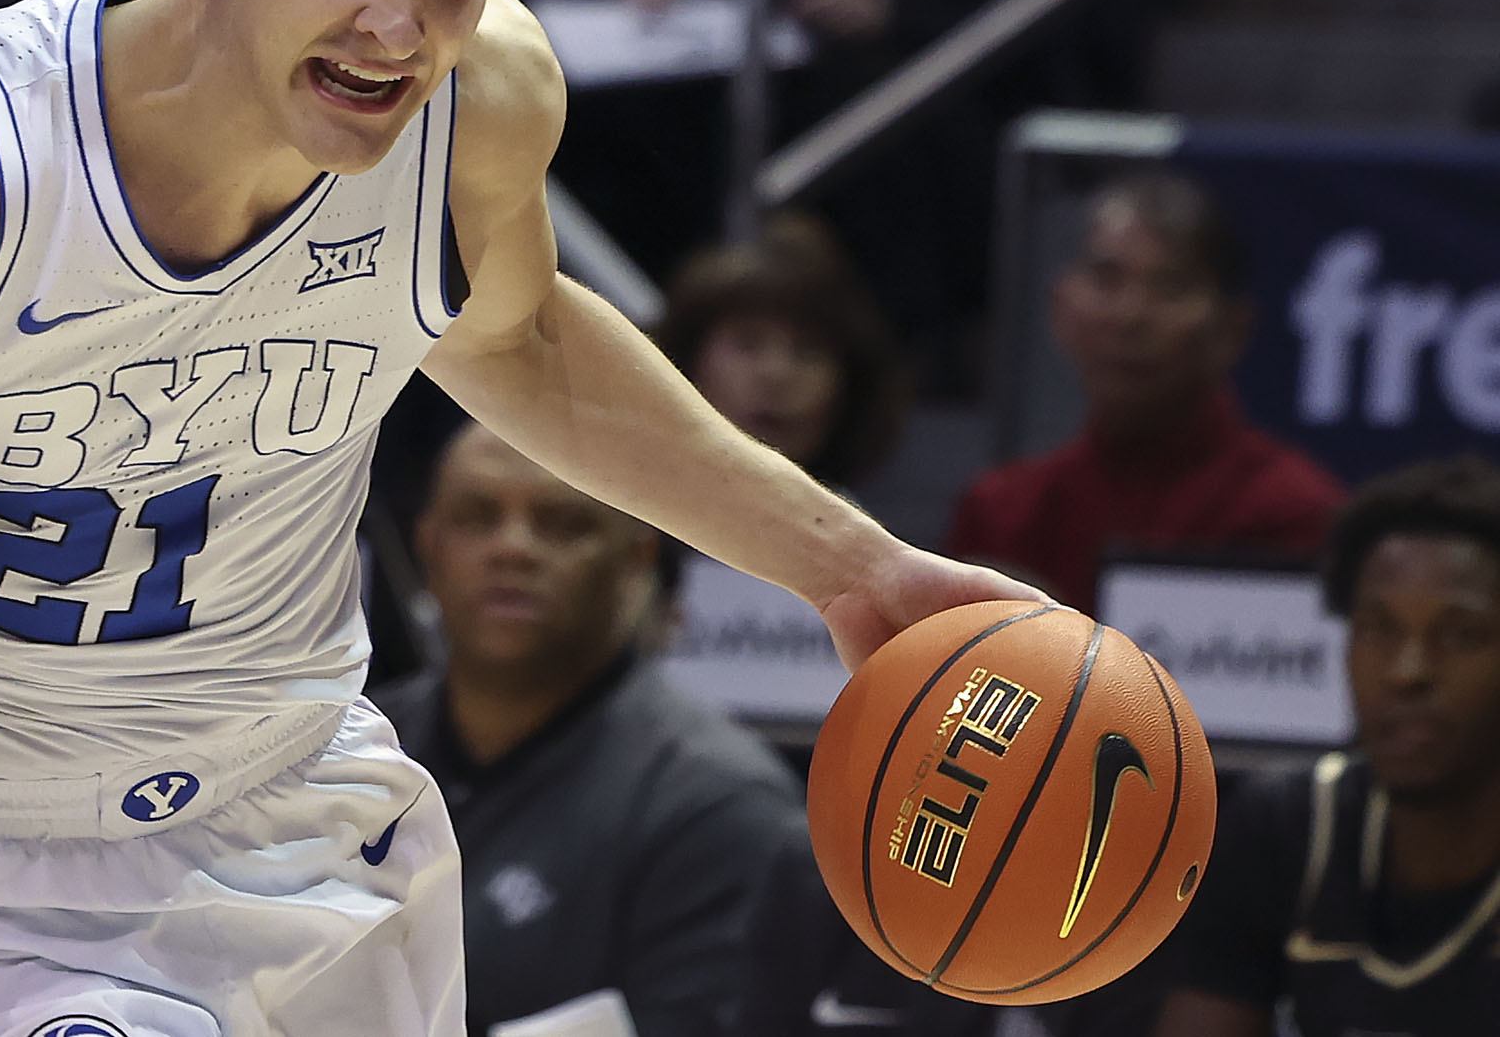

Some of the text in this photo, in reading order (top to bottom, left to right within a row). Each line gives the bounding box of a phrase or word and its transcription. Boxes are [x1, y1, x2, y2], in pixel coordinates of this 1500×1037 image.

[133, 777, 188, 819] Y
[889, 666, 988, 860] CHAMPIONSHIP
[900, 673, 1042, 888] ELITE
